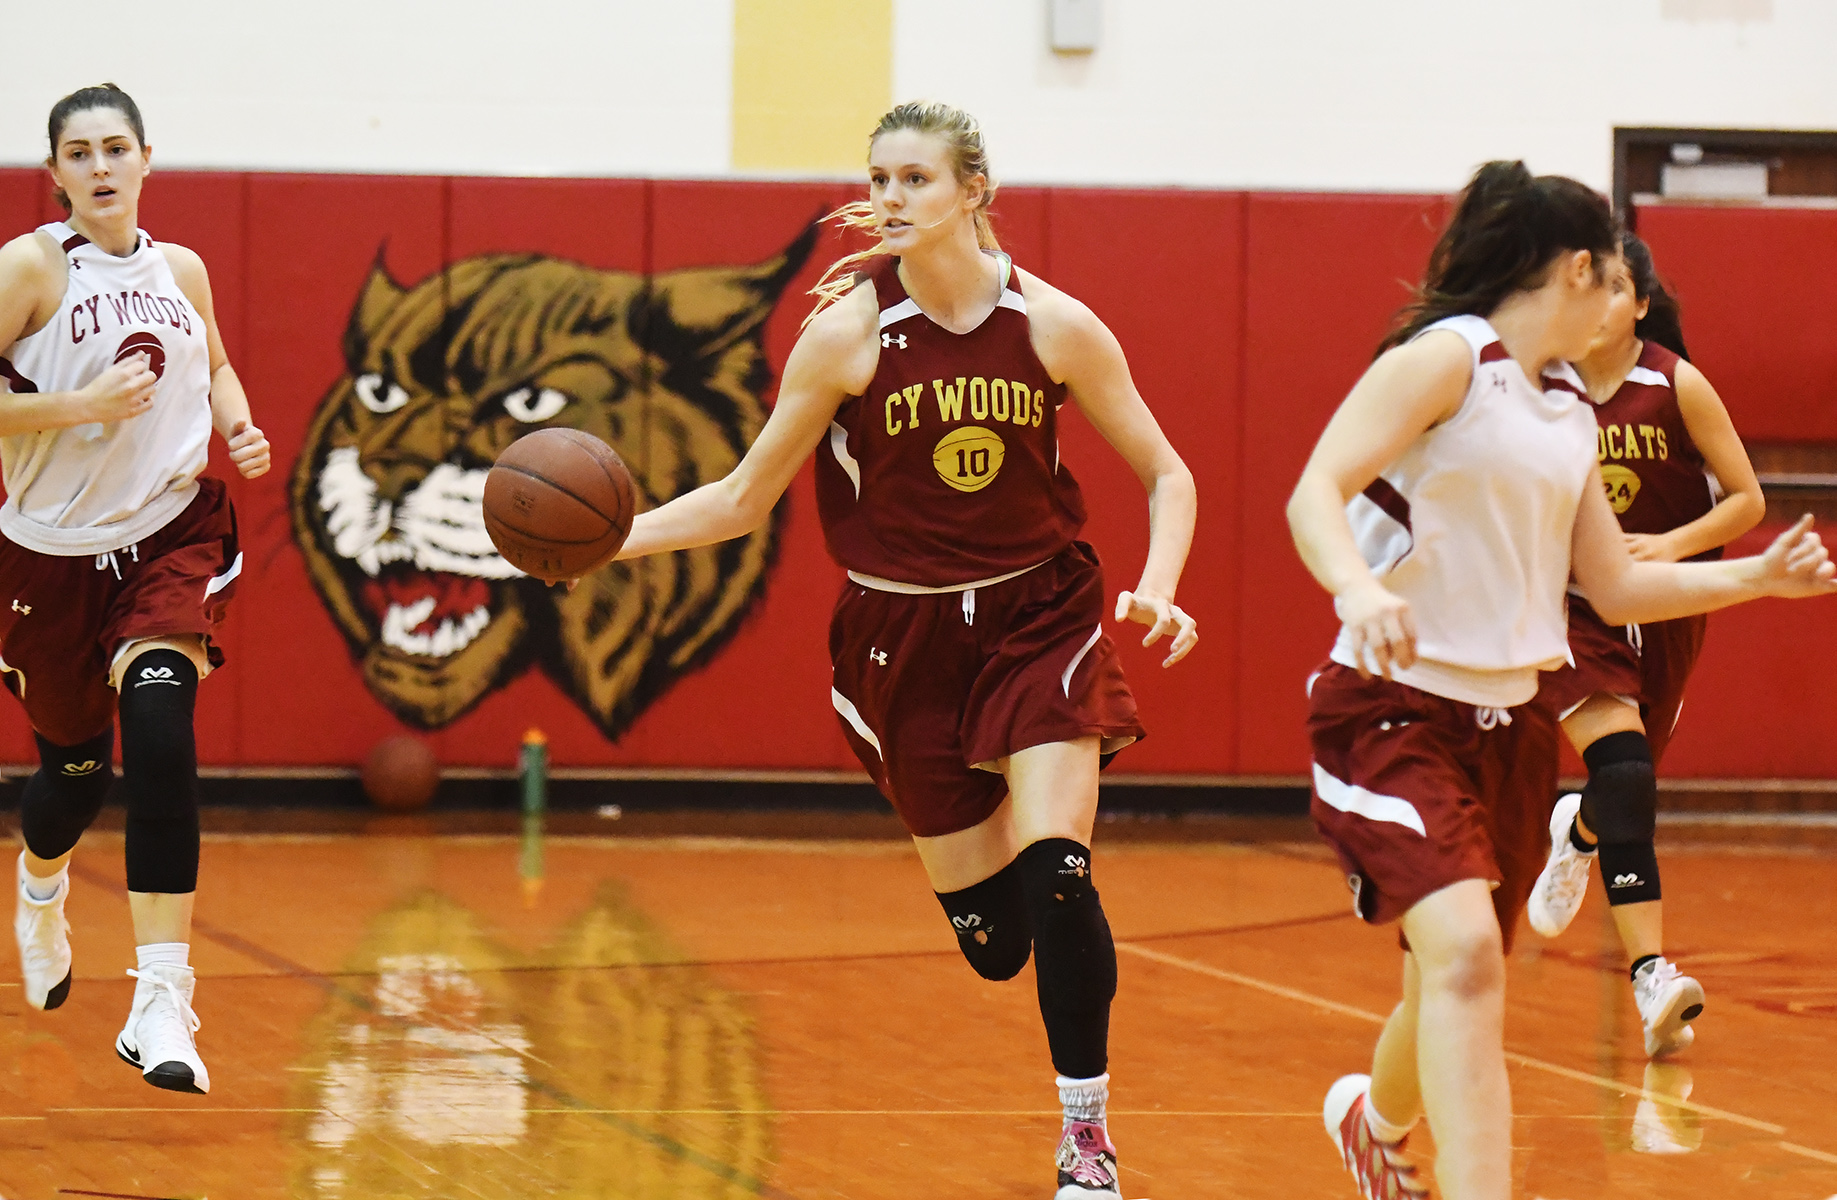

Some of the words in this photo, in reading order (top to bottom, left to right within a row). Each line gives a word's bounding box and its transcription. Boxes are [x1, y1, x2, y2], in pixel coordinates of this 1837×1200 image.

[71, 294, 100, 344] CY
[105, 290, 191, 336] WOODS
[885, 383, 924, 436] CY
[932, 376, 1044, 428] WOODS
[956, 447, 990, 478] 10
